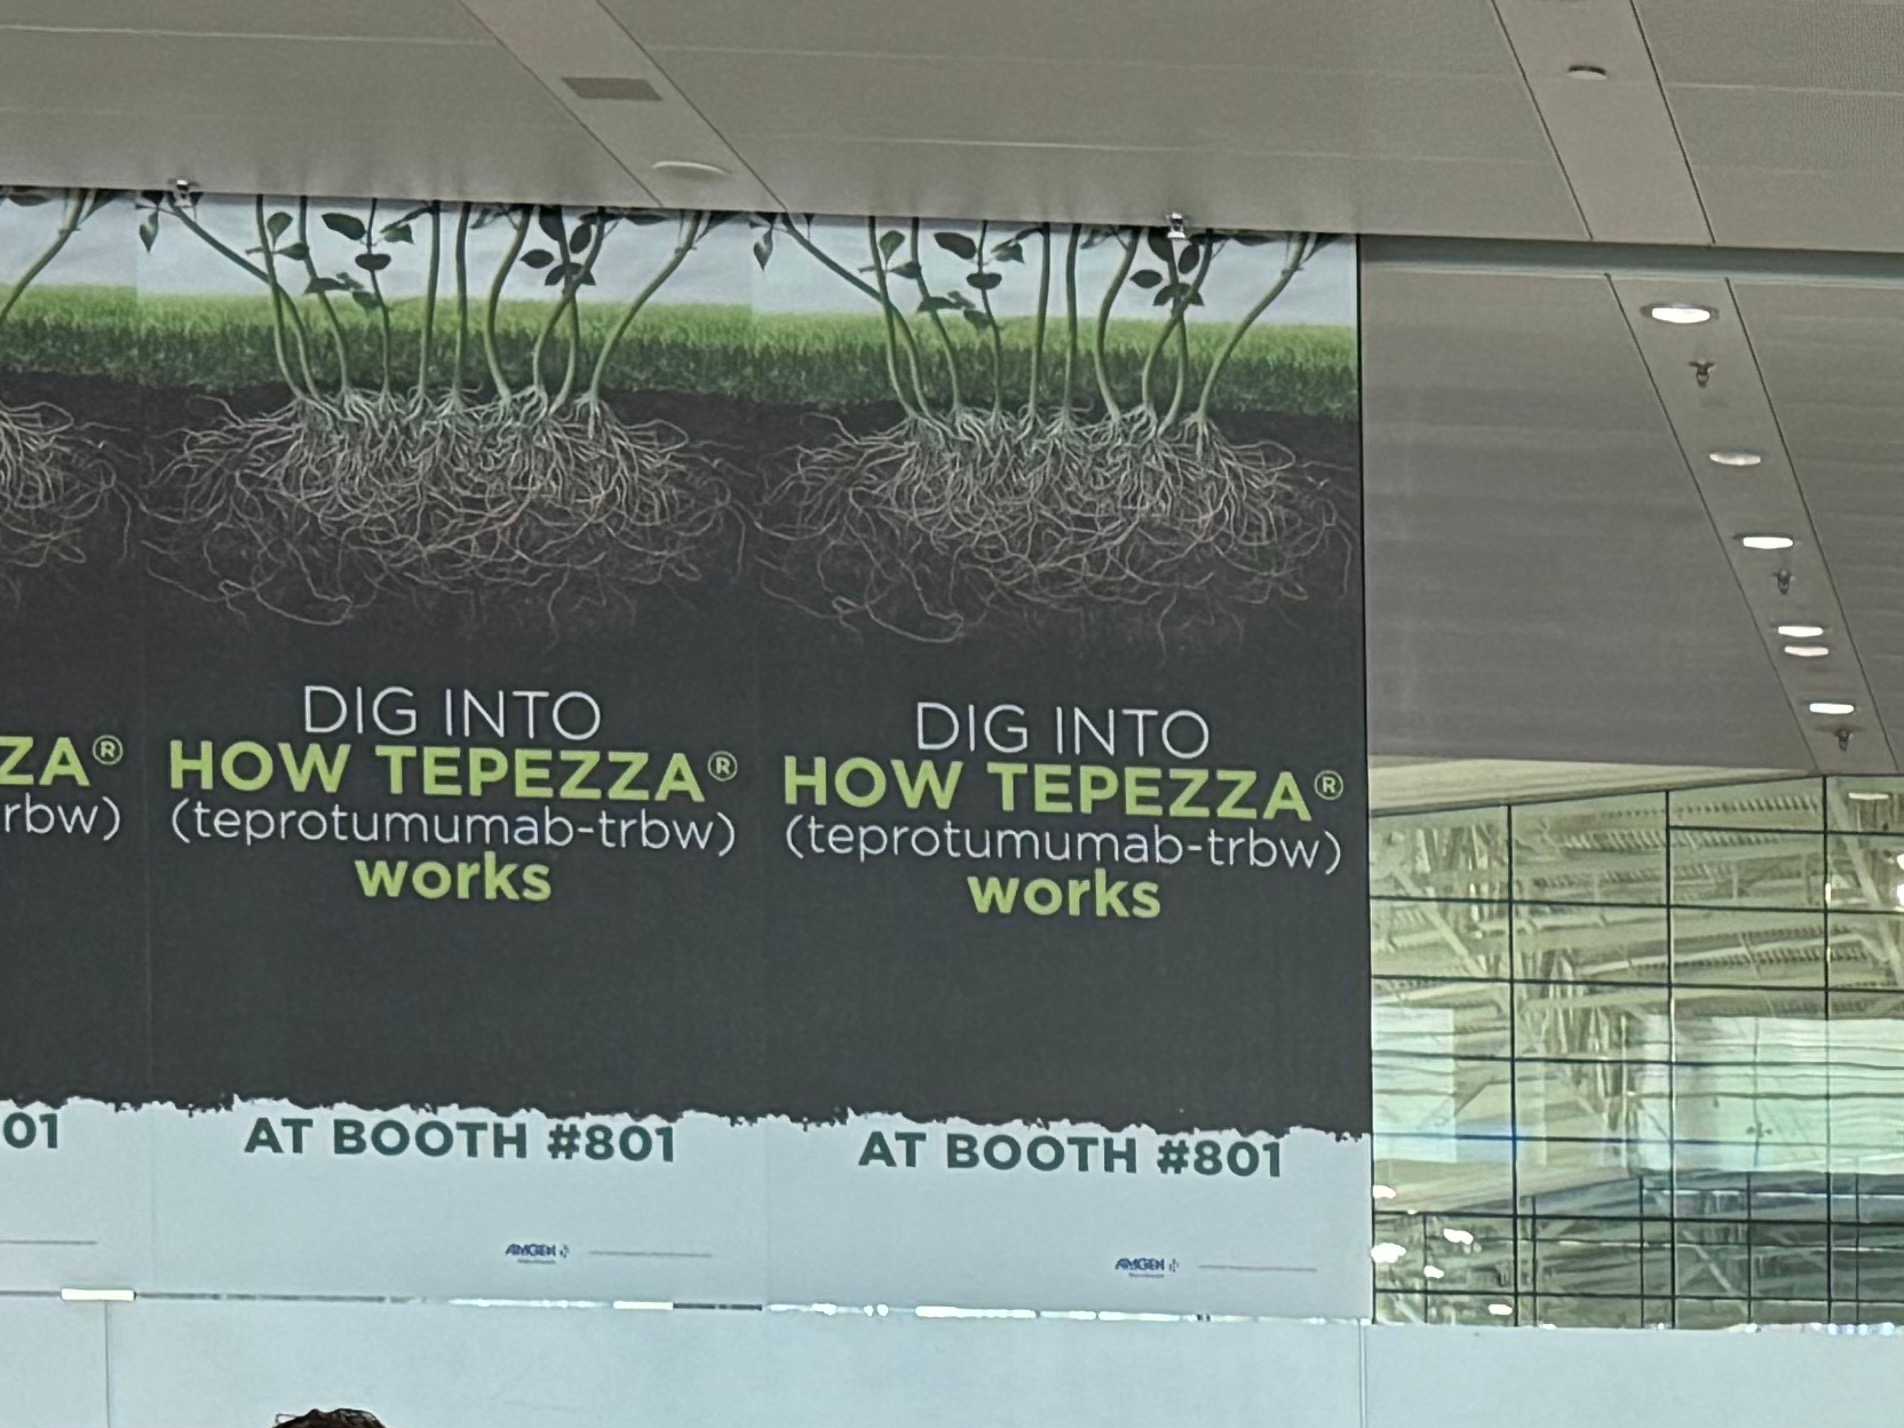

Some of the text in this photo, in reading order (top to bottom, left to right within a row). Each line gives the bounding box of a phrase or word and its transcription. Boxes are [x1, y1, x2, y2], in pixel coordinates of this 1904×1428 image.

[305, 686, 600, 740] DIG INTO
[918, 702, 1208, 759] DIG INTO
[171, 740, 350, 792] HOW
[785, 756, 963, 809] HOW
[173, 797, 734, 856] (teprotumumab-trbw)
[786, 814, 1340, 874] (teprotumumab-trbw)
[355, 851, 550, 900] works
[967, 868, 1160, 918] works
[245, 1116, 675, 1163] AT BOOTH #801
[858, 1131, 1281, 1178] AT BOOTH #801
[505, 1243, 556, 1257] AMGEN
